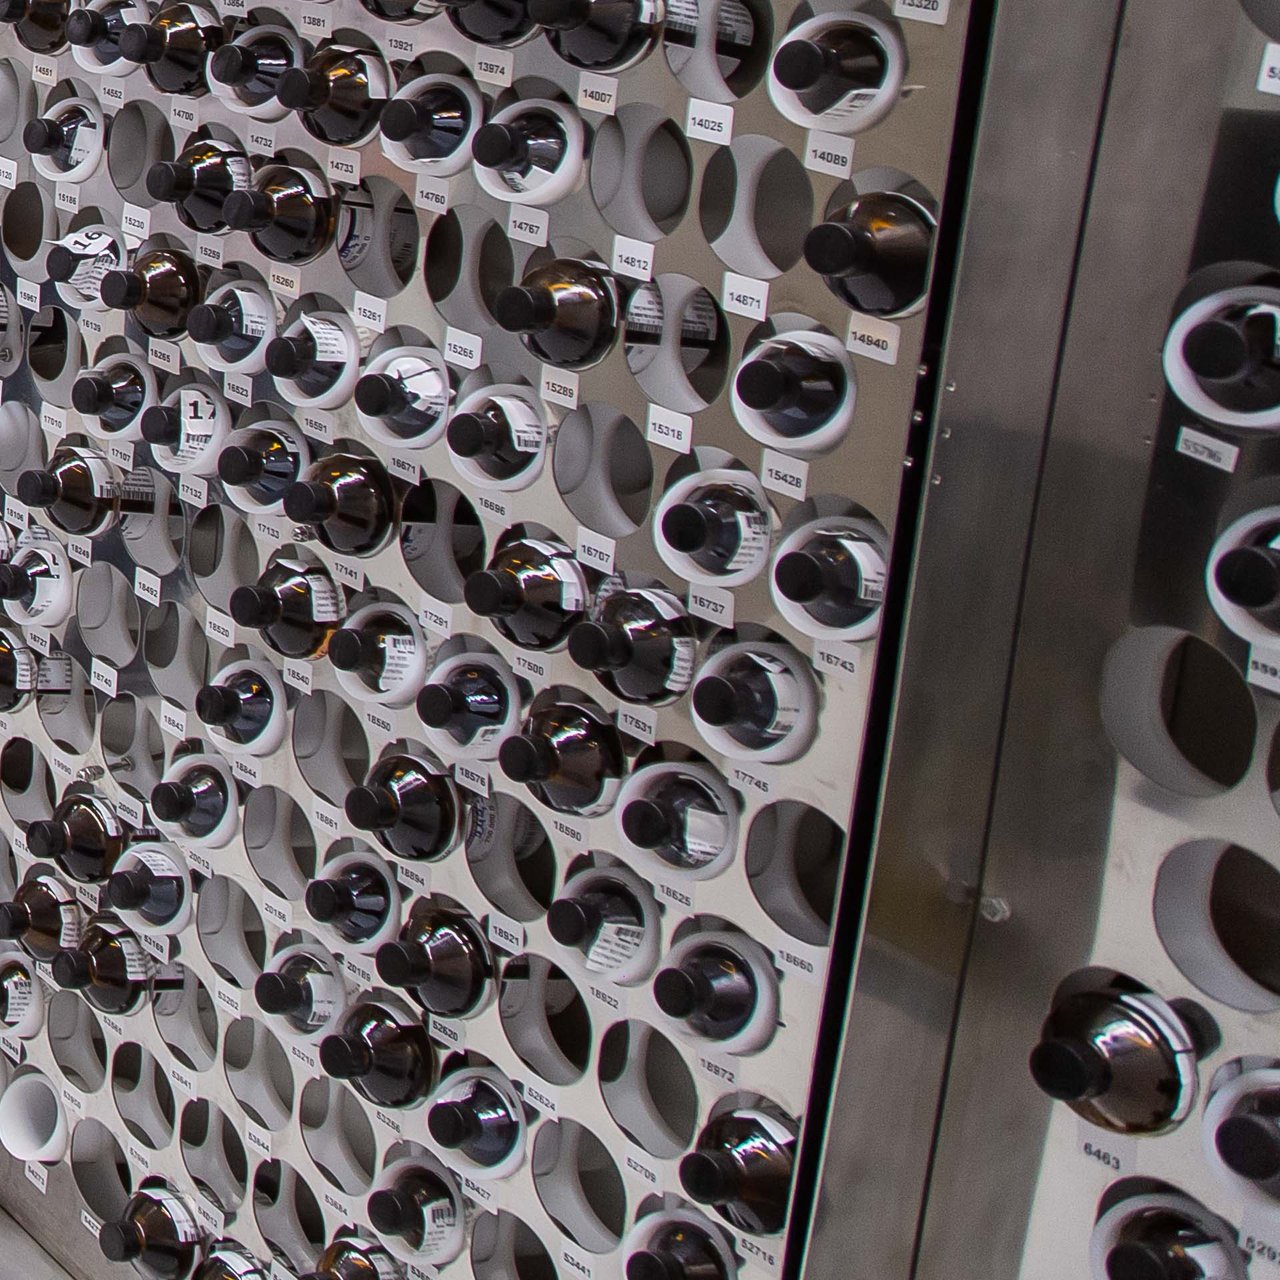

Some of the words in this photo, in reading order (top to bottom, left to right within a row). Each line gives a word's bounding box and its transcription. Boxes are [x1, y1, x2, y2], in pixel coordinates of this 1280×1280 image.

[388, 38, 414, 53] 13921
[477, 61, 506, 76] 13974
[582, 88, 613, 104] 14007
[172, 108, 194, 122] 14700
[691, 116, 724, 133] 14025
[250, 134, 273, 149] 14732
[329, 160, 354, 174] 14733
[811, 149, 848, 167] 14089
[419, 189, 446, 205] 14760
[124, 216, 145, 230] 15230
[512, 219, 541, 235] 14767
[618, 254, 649, 271] 14812
[728, 291, 761, 309] 14871
[357, 306, 382, 323] 15261
[851, 331, 889, 351] 14940
[447, 342, 474, 360] 15265
[545, 381, 574, 399] 15289
[181, 483, 202, 500] 17132
[257, 522, 280, 540] 17133
[581, 544, 611, 563] 16707
[334, 562, 358, 581] 17141
[691, 594, 726, 615] 16737
[423, 610, 449, 629] 17291
[516, 656, 544, 677] 17500
[818, 651, 855, 674] 16743
[622, 713, 653, 735] 17531
[734, 769, 769, 793] 17745
[659, 884, 691, 907] 18625
